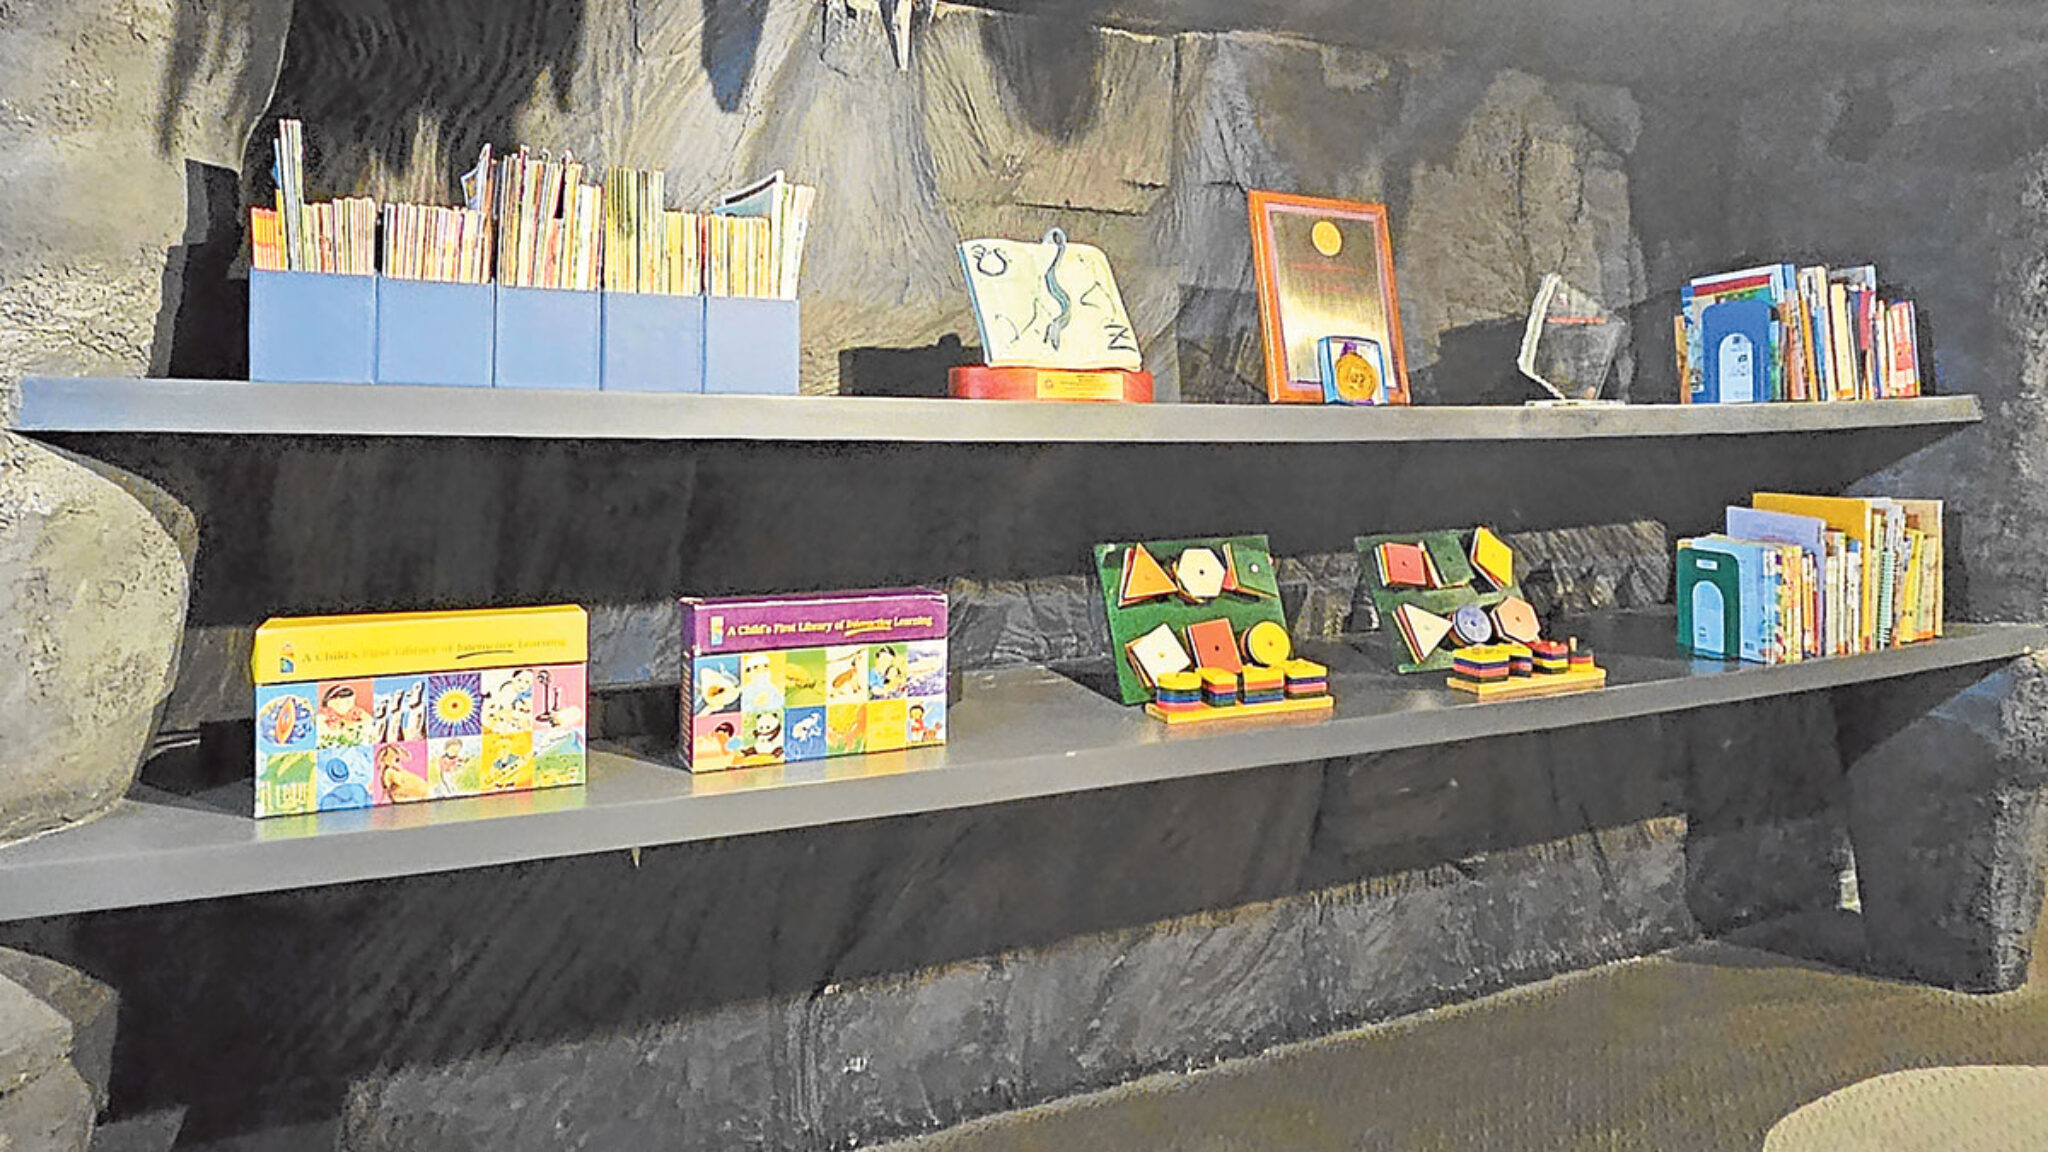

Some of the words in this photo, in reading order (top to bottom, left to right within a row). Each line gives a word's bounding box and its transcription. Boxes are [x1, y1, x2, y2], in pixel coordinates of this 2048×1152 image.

[727, 626, 736, 637] A
[738, 623, 772, 636] Child's
[774, 622, 796, 634] First
[798, 621, 834, 634] Library
[834, 619, 844, 630] of
[894, 616, 933, 628] Learning
[302, 652, 312, 662] A
[315, 649, 359, 661] Child's
[394, 644, 438, 657] Library
[440, 641, 453, 654] of
[517, 637, 568, 648] Learning
